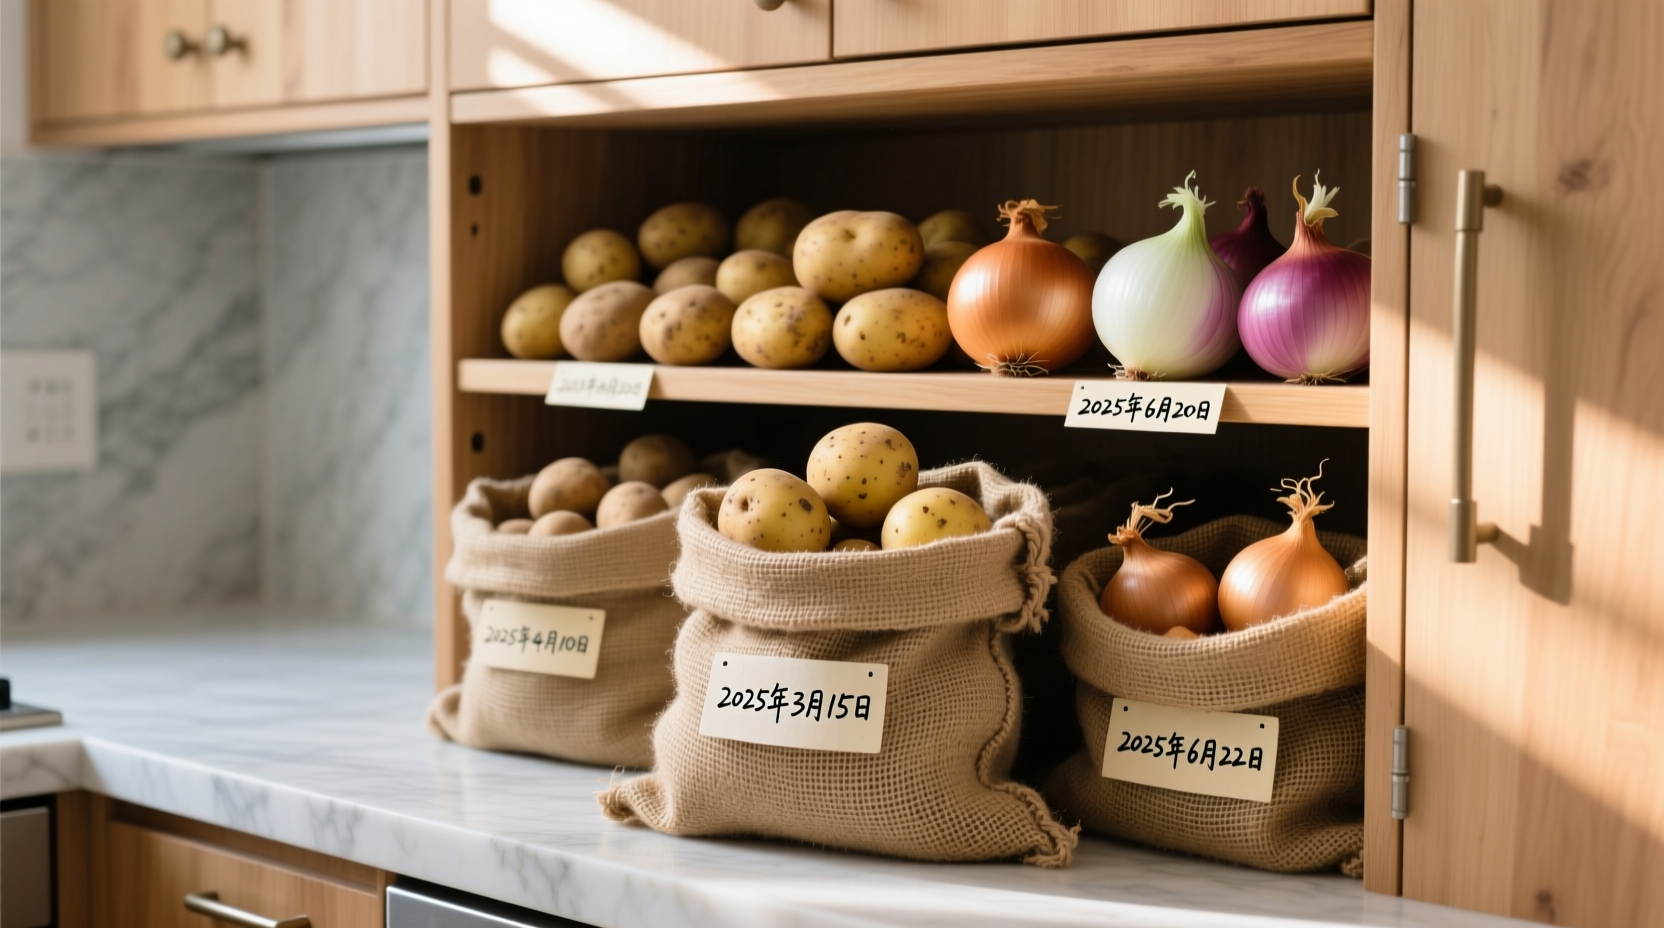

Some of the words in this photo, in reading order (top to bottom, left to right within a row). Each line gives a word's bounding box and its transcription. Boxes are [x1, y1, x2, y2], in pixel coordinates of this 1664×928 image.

[1077, 392, 1211, 423] 2025年6月20日
[484, 625, 589, 655] 2025年4月10日
[717, 682, 870, 724] 2025年3月15日
[1117, 731, 1263, 771] 2025年6月22日
